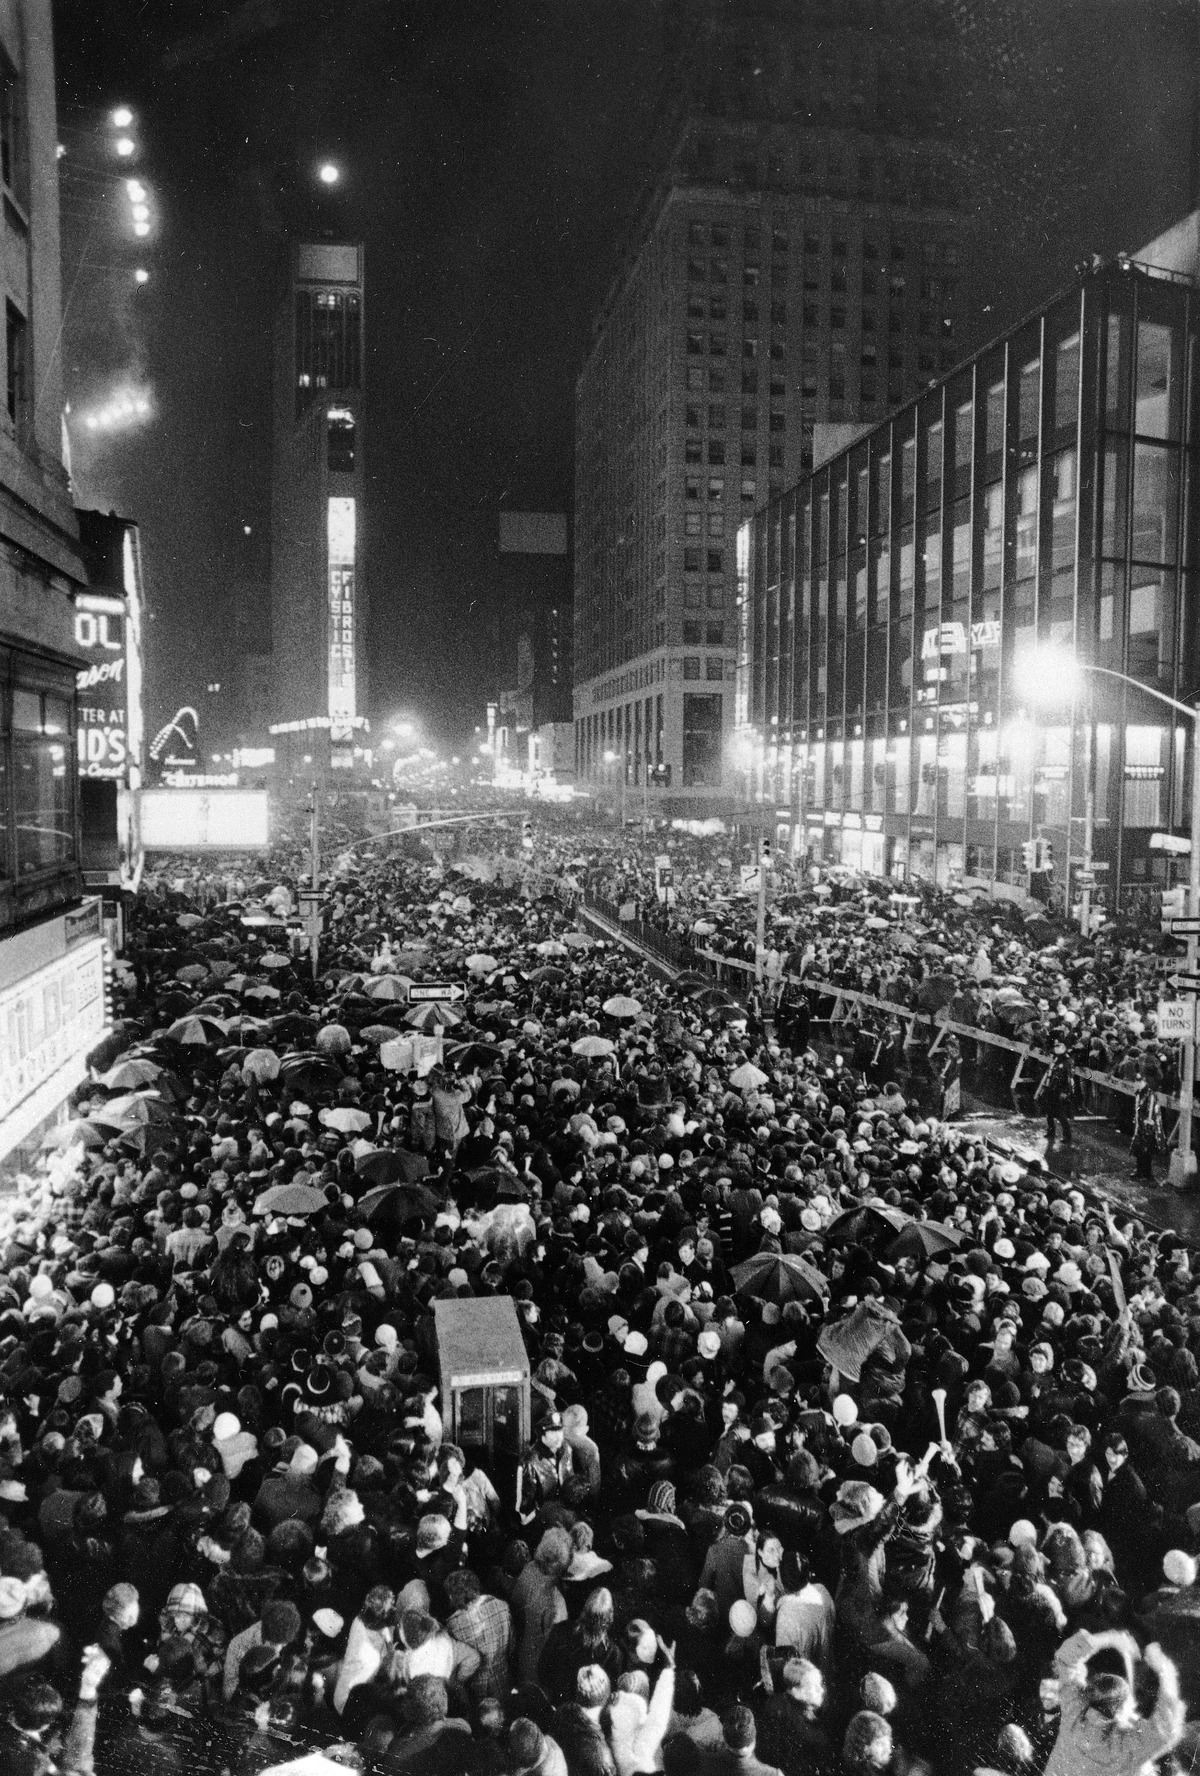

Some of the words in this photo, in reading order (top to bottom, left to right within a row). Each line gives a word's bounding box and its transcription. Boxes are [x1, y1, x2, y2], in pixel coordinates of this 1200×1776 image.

[342, 571, 353, 687] FIBROSI
[109, 709, 125, 723] AT
[414, 989, 430, 997] ONE
[1168, 1007, 1183, 1018] NO
[1161, 1019, 1191, 1030] TURNS
